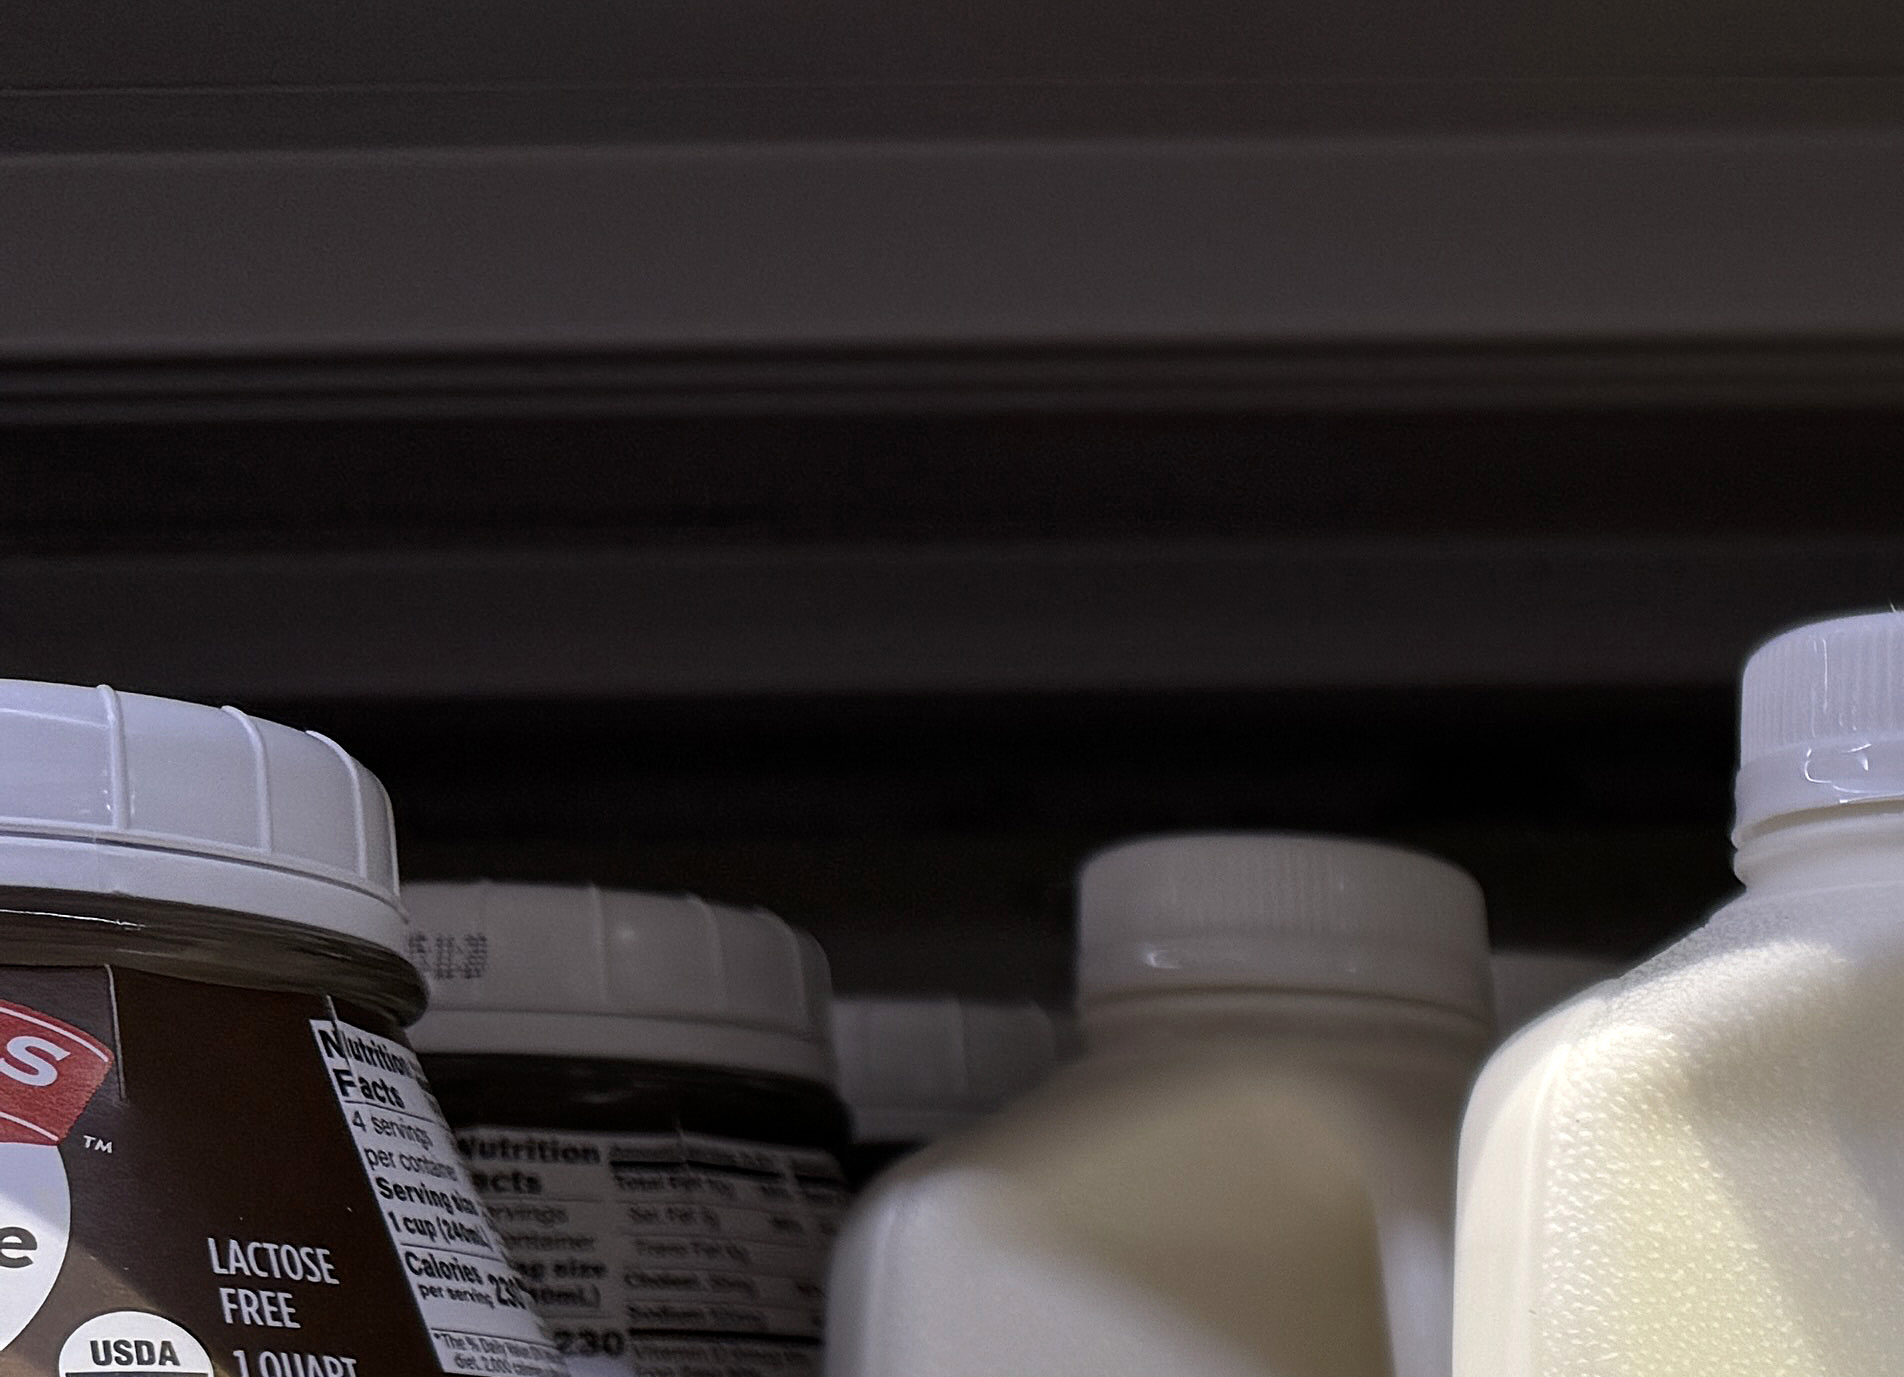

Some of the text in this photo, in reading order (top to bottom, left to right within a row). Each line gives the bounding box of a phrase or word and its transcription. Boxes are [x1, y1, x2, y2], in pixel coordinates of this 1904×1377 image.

[333, 1069, 405, 1108] Facts
[209, 1238, 339, 1285] LACTOSE
[405, 1251, 483, 1285] Calories
[221, 1288, 300, 1329] FREE
[91, 1339, 181, 1367] USDA
